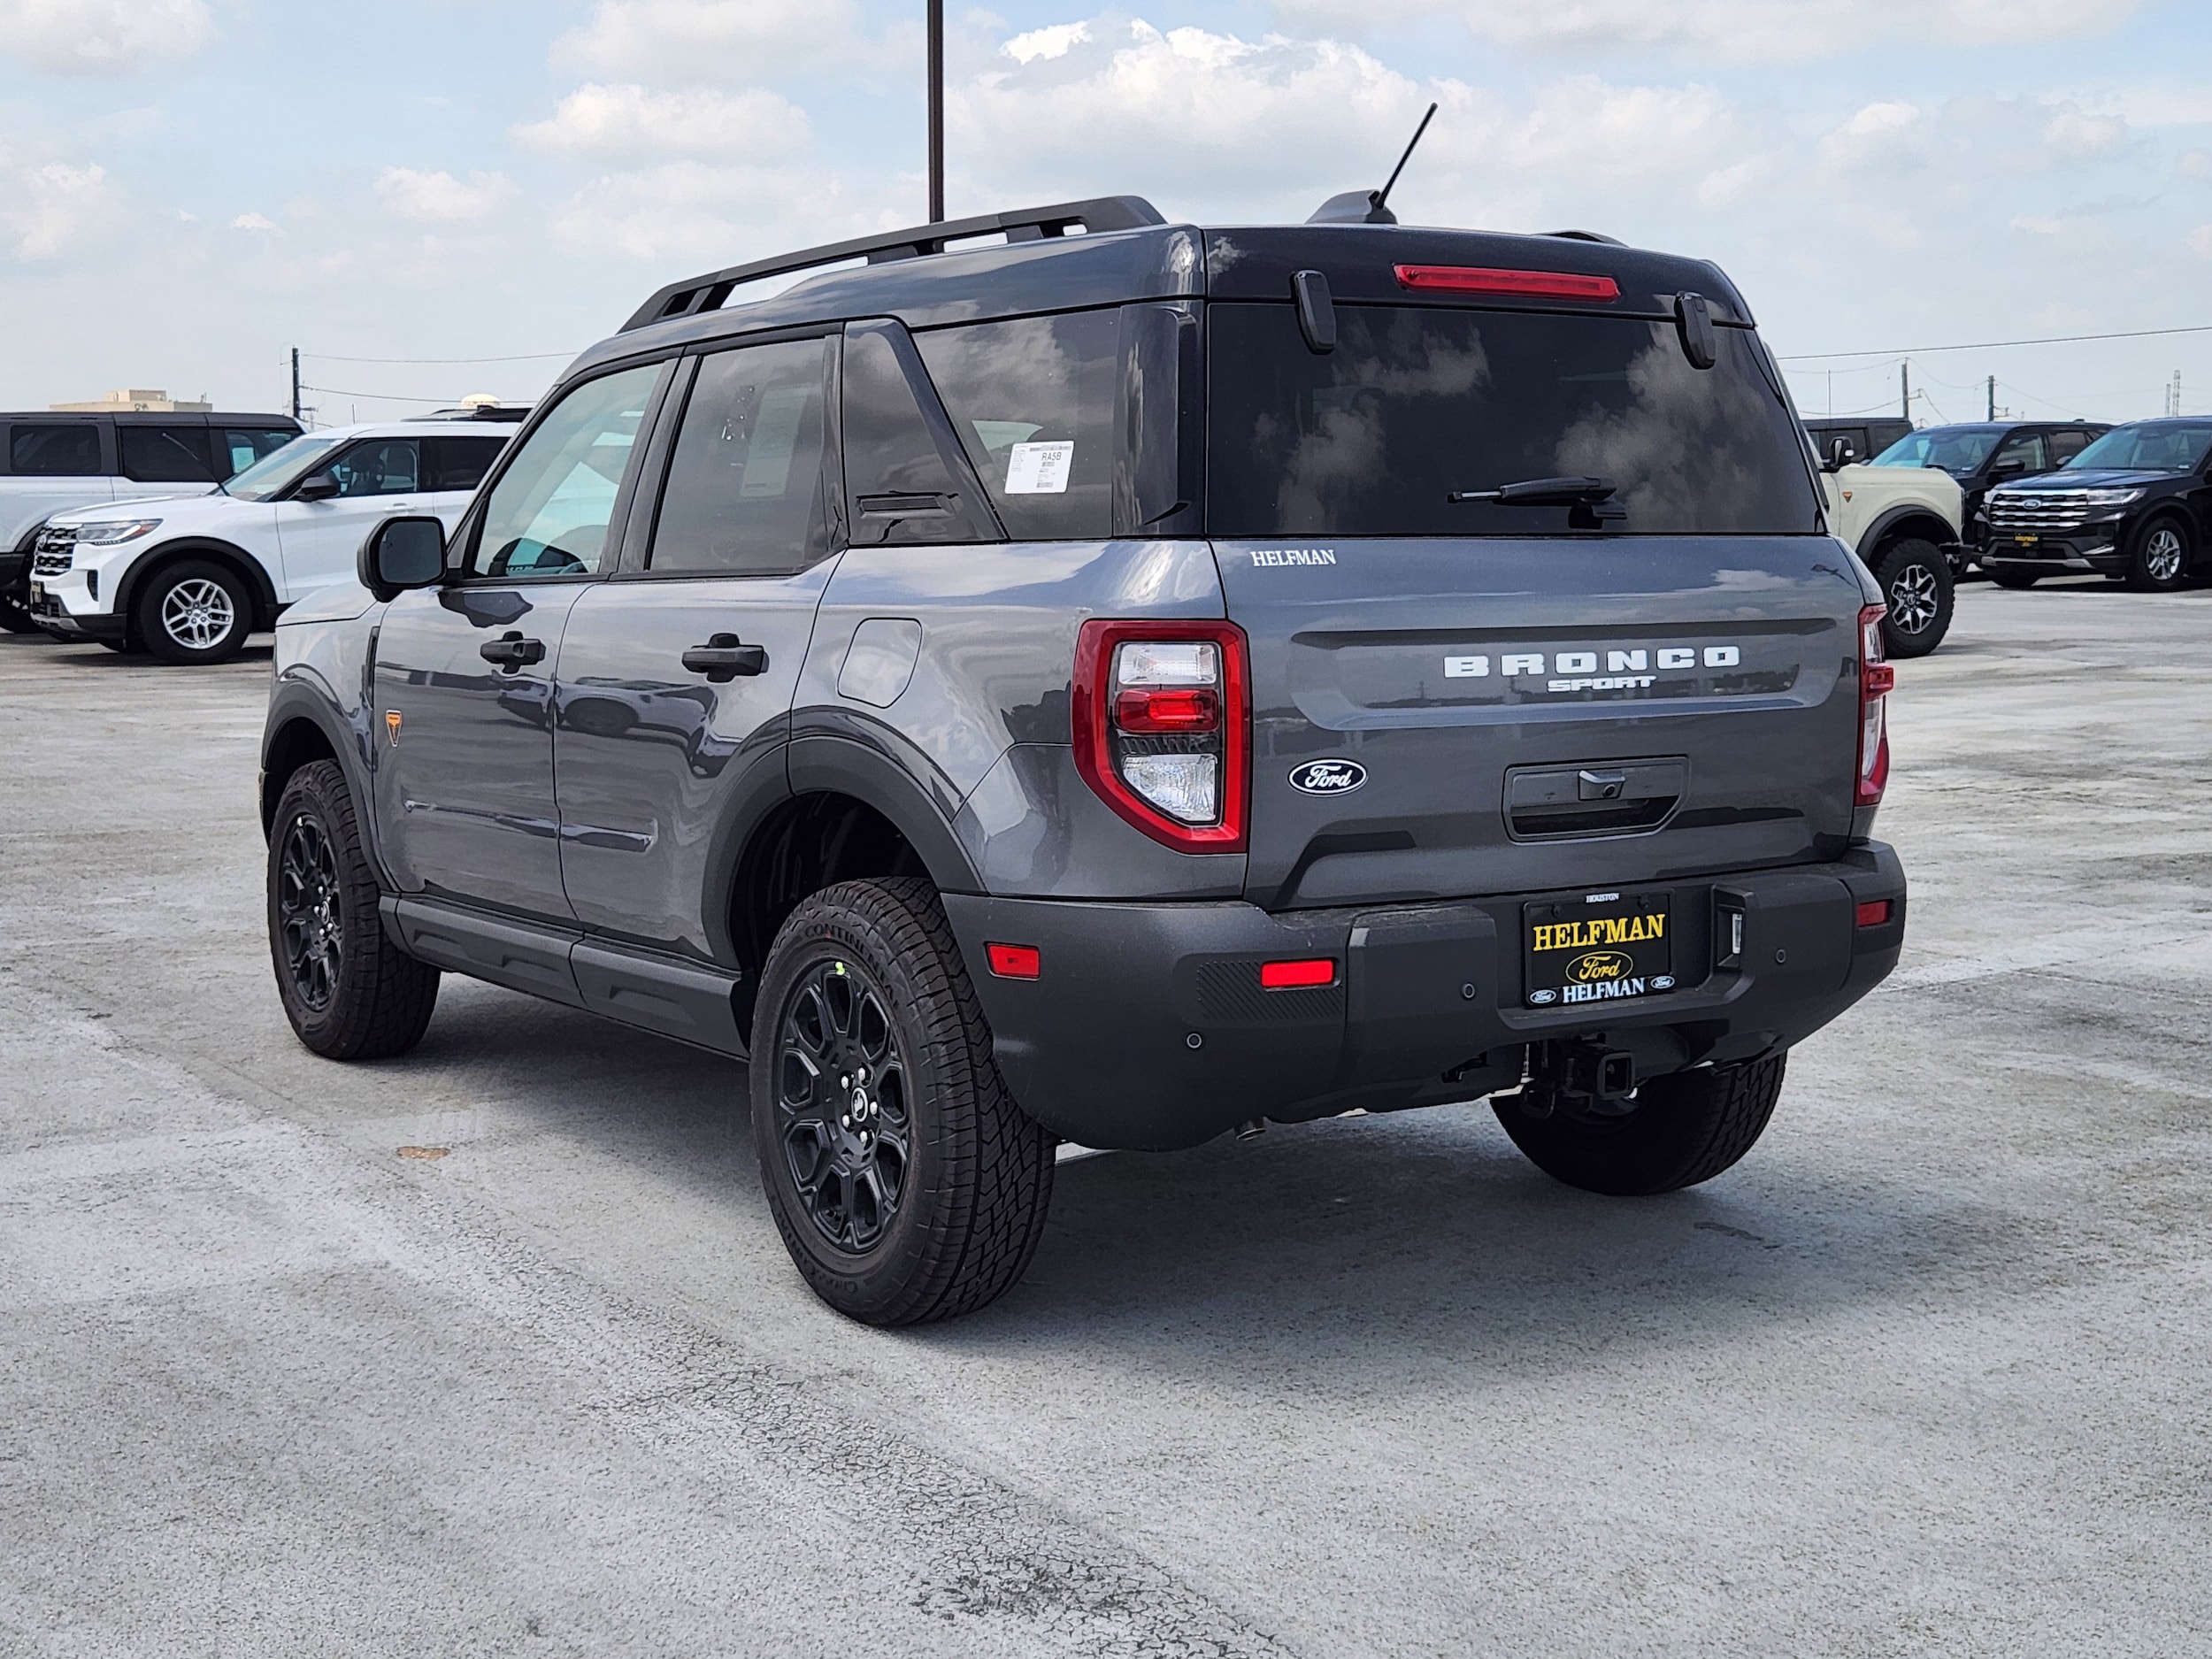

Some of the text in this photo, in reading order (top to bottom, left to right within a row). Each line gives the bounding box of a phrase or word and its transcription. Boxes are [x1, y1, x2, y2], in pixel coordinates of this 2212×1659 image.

[1249, 549, 1337, 567] HELFMAN
[1443, 646, 1740, 678] BRONCO
[1548, 675, 1657, 692] SPORT
[1304, 764, 1354, 788] Ford
[1586, 892, 1620, 903] HOUSTON
[1532, 913, 1666, 952] HELFMAN
[1578, 955, 1622, 980] Ford
[1562, 977, 1646, 1003] HELFMAN
